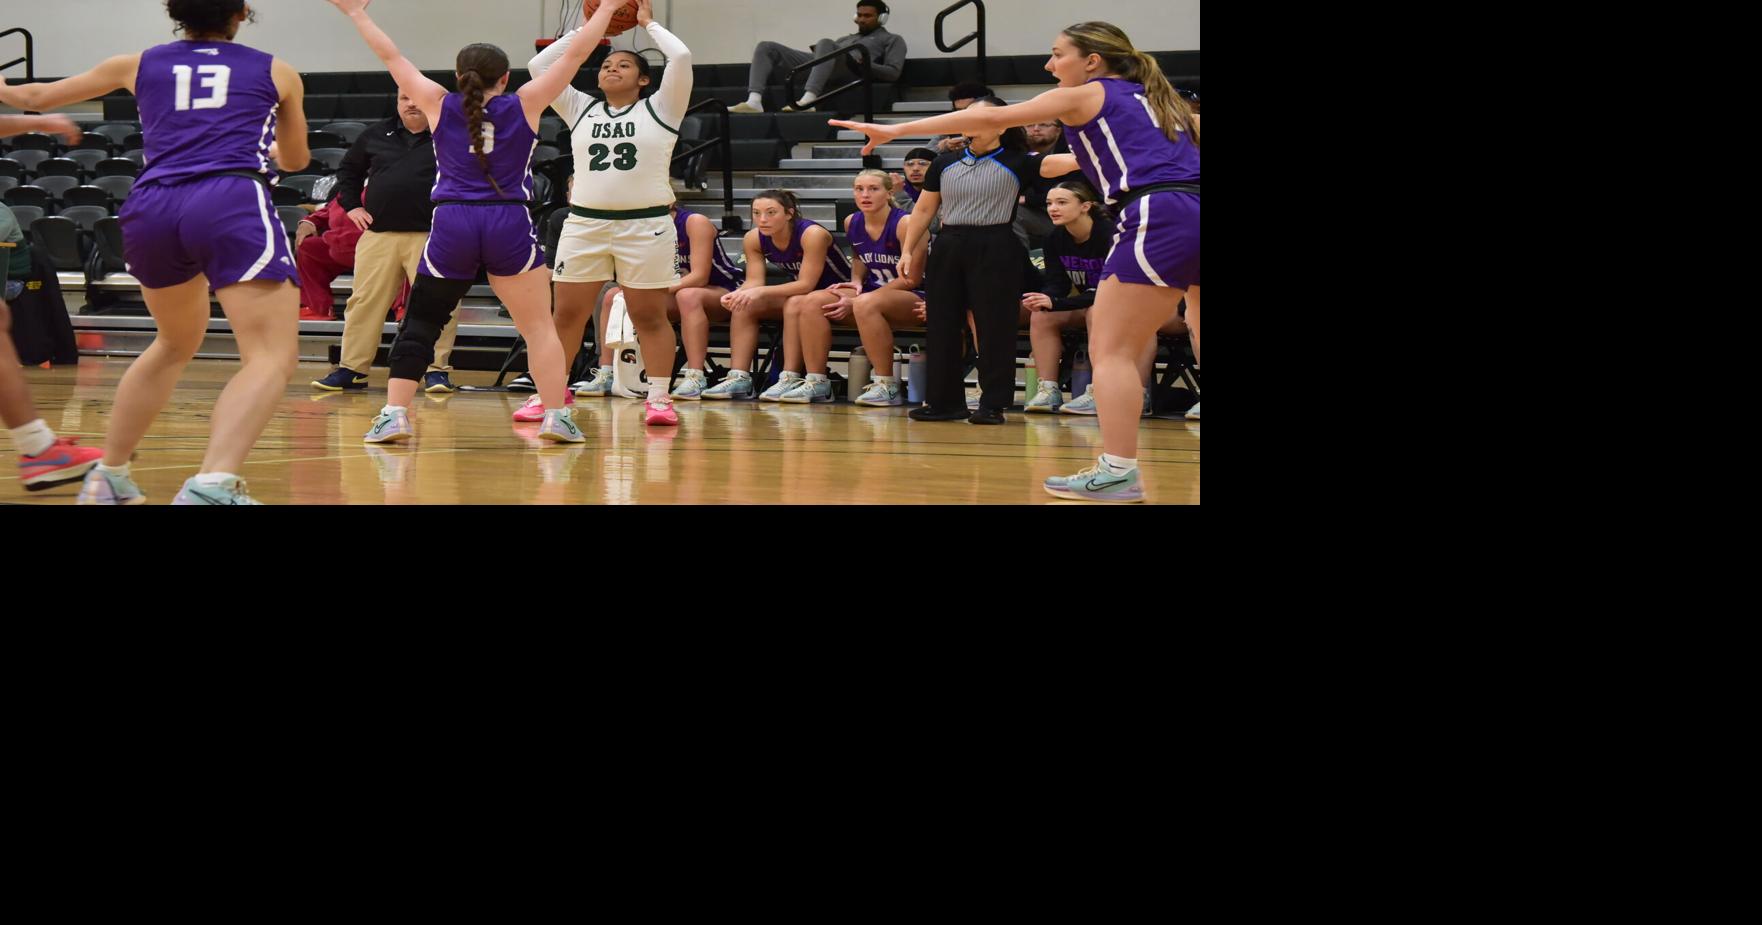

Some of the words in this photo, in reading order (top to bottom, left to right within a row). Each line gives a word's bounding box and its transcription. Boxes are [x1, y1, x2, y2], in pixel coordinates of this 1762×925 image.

[172, 64, 232, 112] 13
[591, 121, 635, 139] USAO
[588, 142, 638, 172] 23
